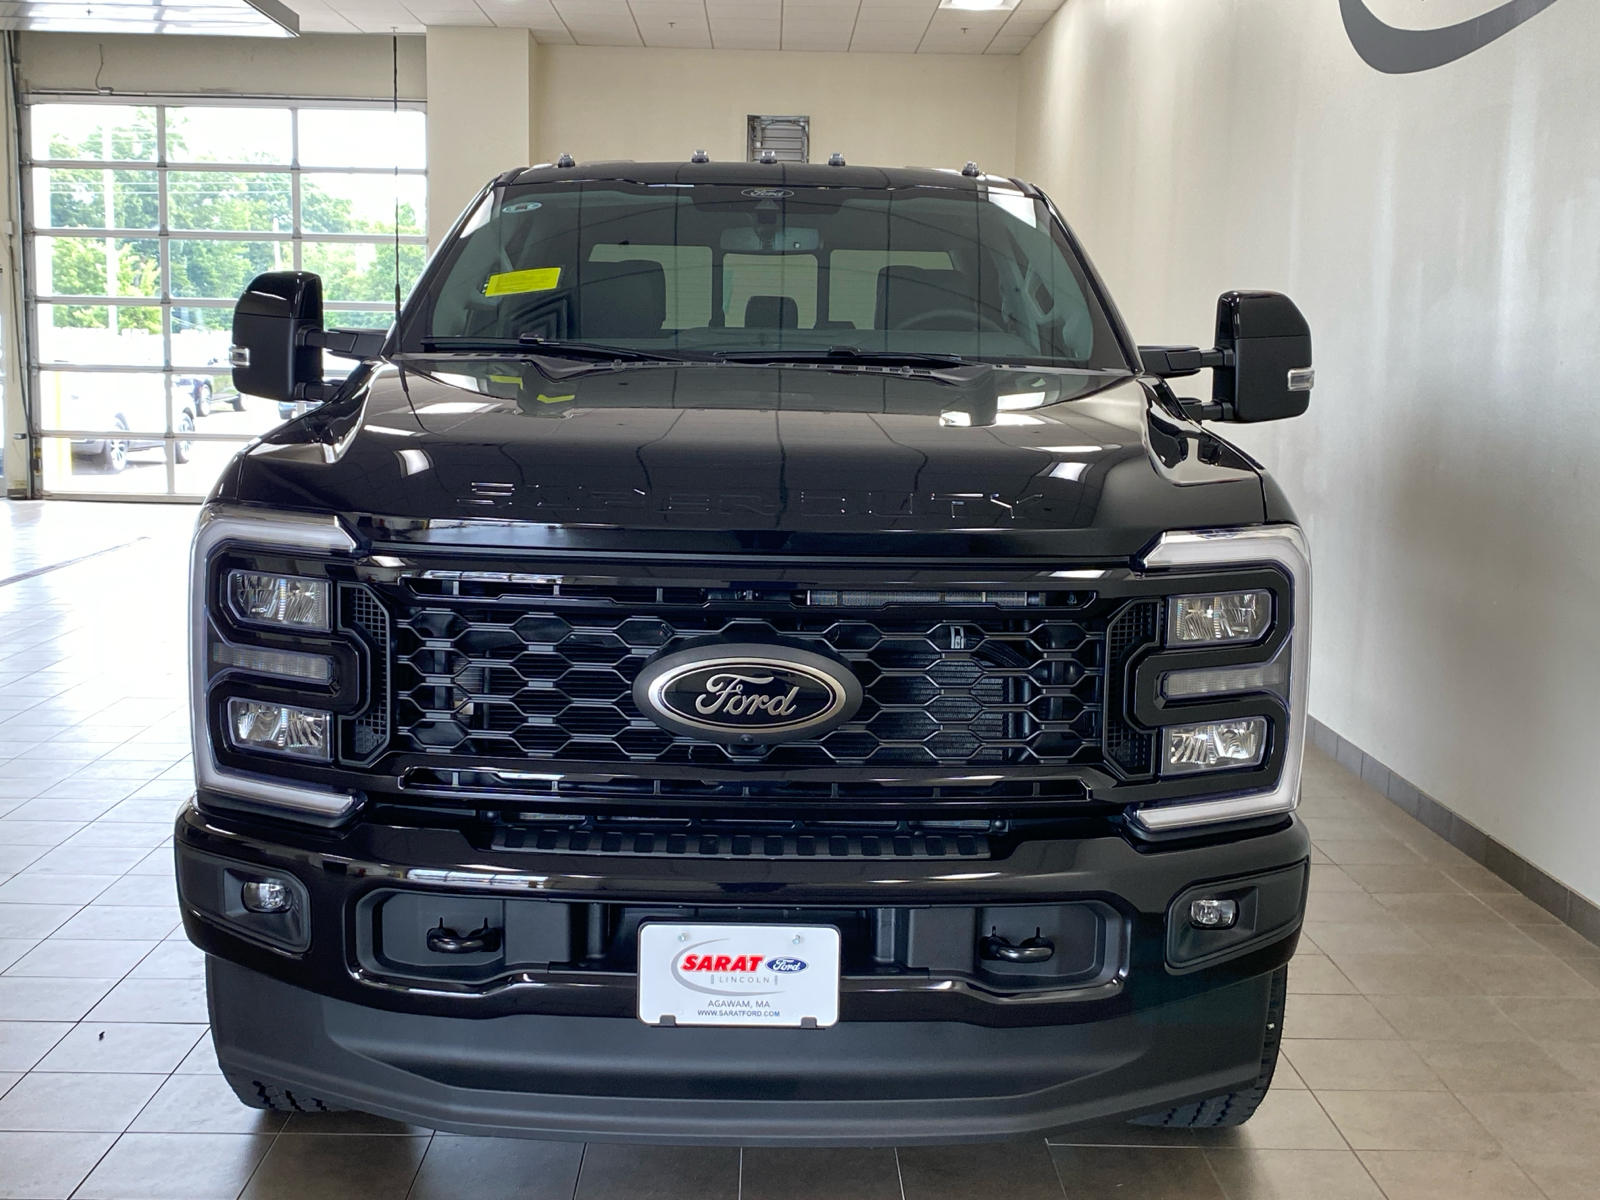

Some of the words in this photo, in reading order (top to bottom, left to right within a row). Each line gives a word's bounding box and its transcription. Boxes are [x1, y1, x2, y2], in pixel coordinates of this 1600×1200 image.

[750, 188, 785, 197] Ford
[695, 673, 800, 716] Ford
[681, 954, 765, 973] SARAT
[772, 958, 802, 972] Ford
[719, 976, 770, 984] LINCOLN
[707, 1000, 753, 1009] AGAWAM,
[756, 1000, 771, 1009] MA
[697, 1009, 781, 1018] WWW.SARATFORD.COM
